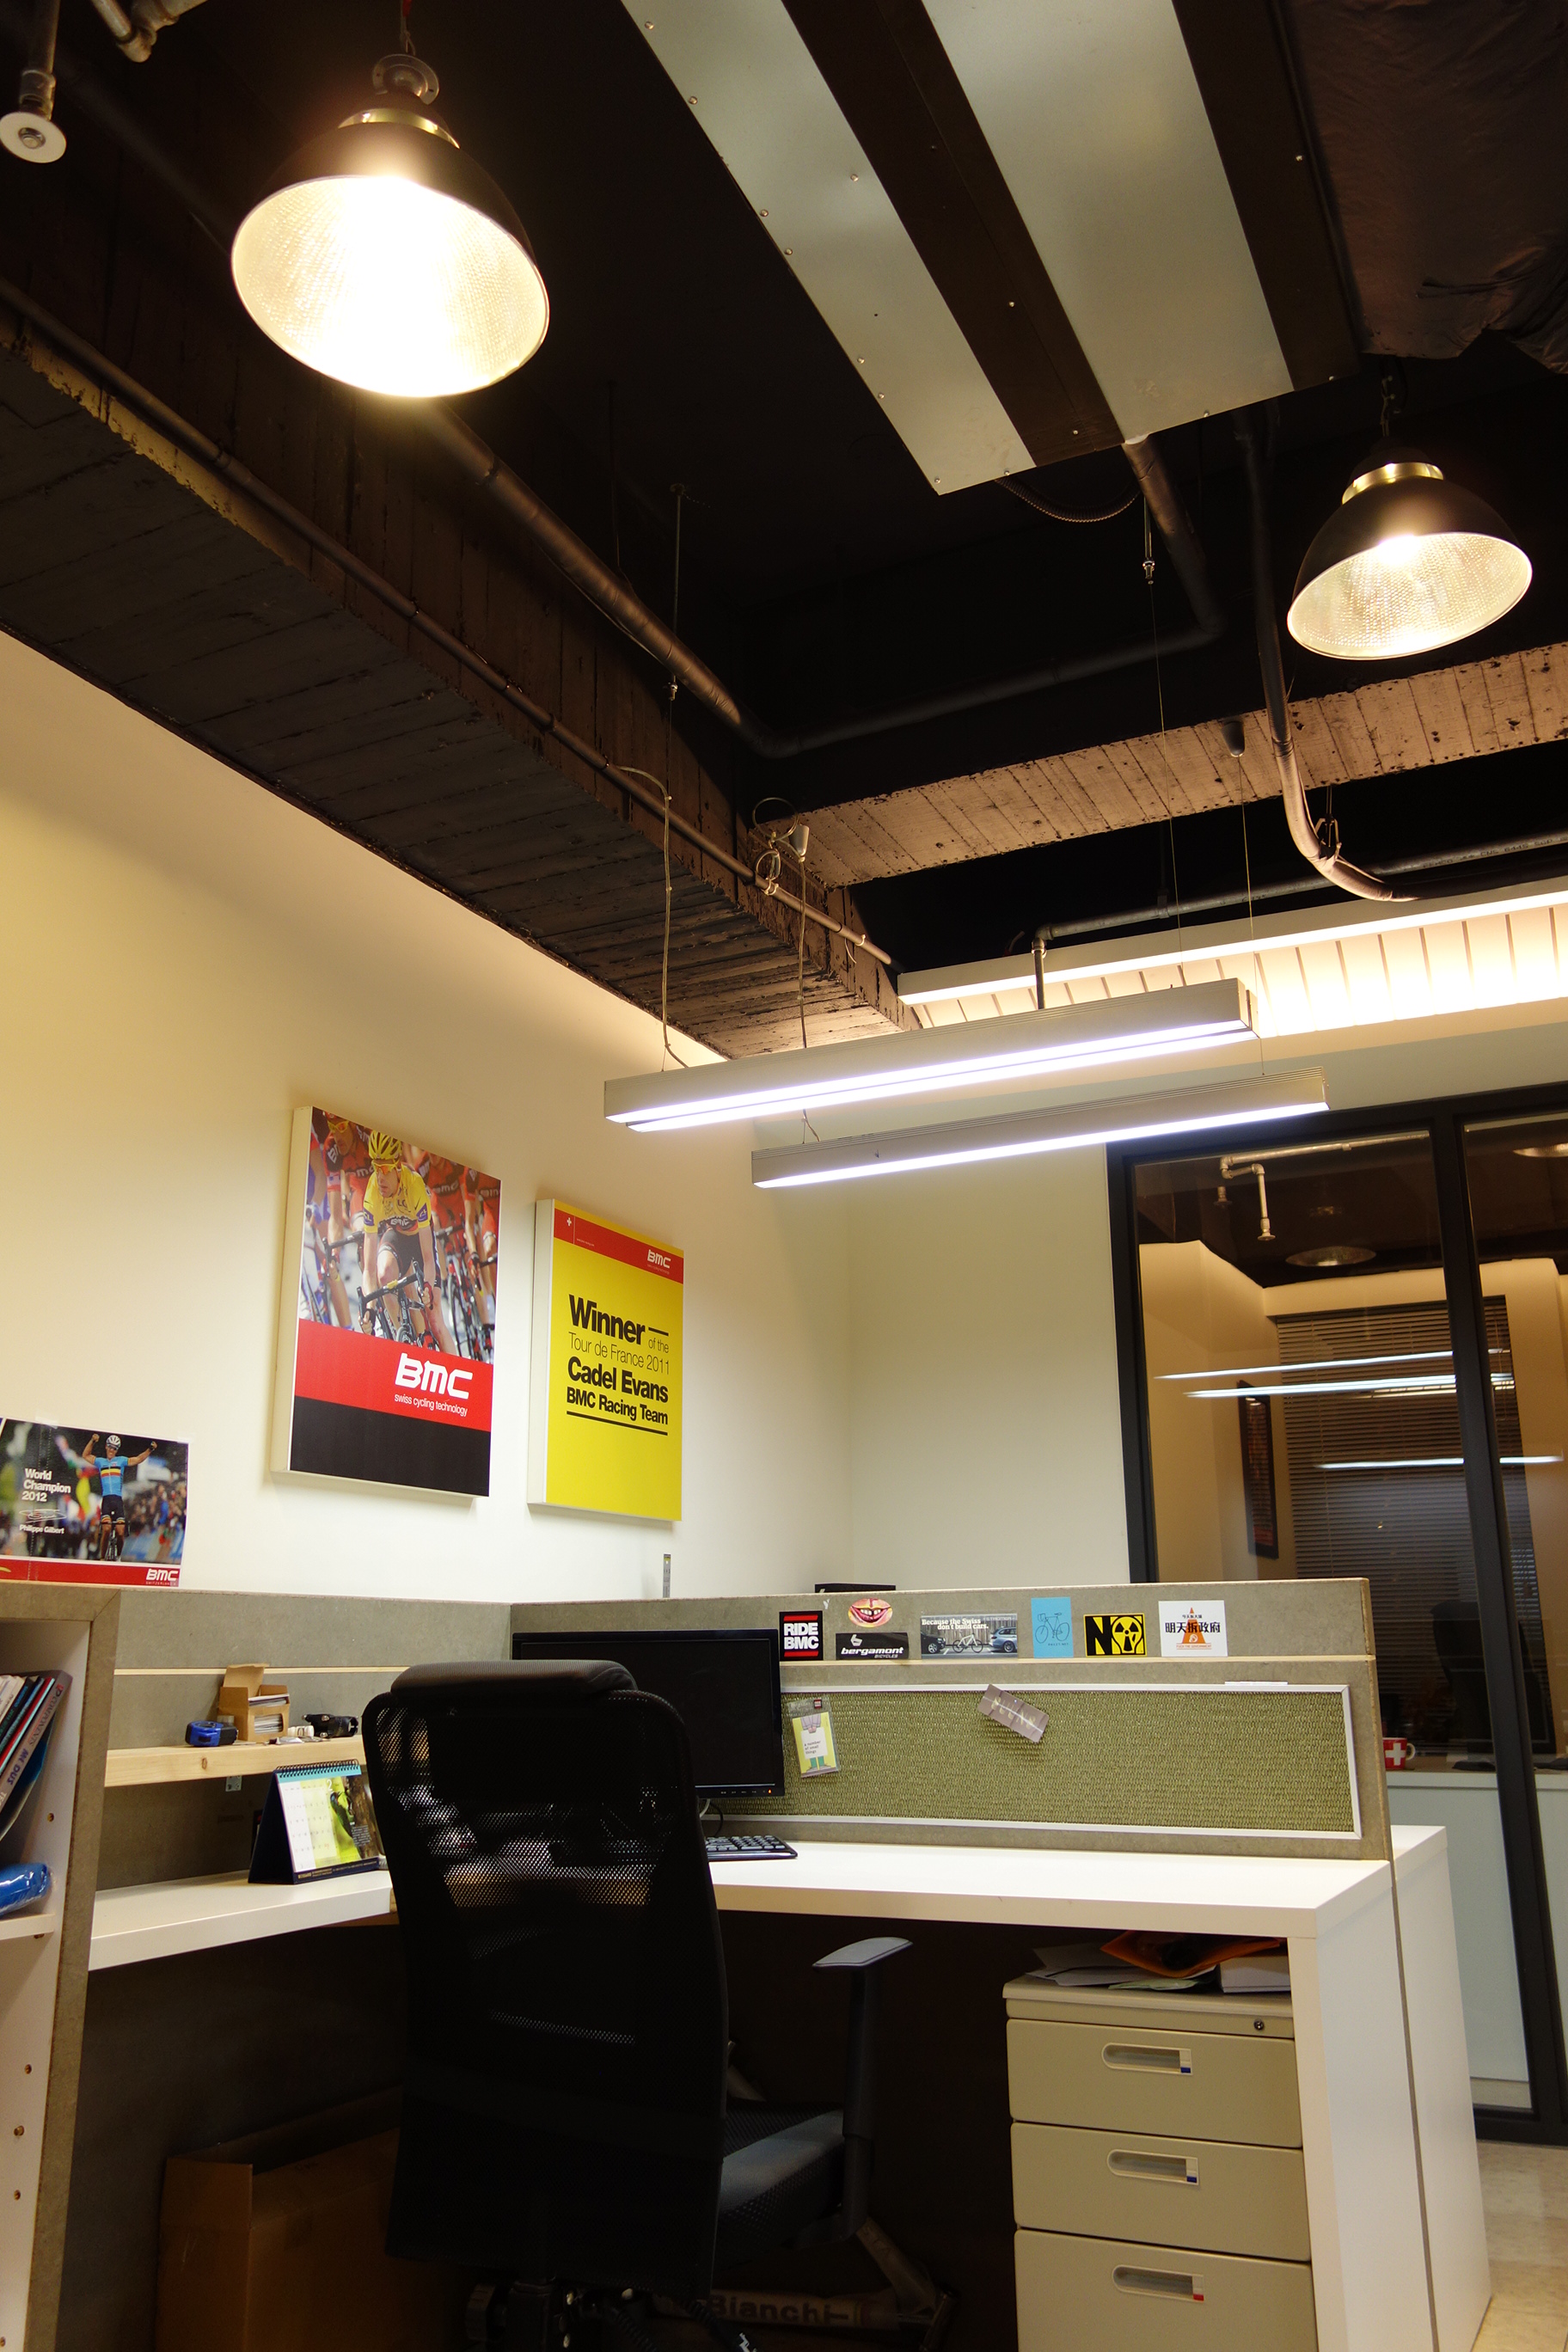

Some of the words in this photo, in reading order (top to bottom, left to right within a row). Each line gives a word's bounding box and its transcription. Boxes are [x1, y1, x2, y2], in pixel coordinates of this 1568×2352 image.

[647, 1249, 671, 1269] BMC
[569, 1294, 646, 1345] Winner
[648, 1338, 656, 1350] of
[657, 1339, 669, 1354] the
[568, 1332, 591, 1353] Tour
[595, 1340, 608, 1357] de
[610, 1344, 644, 1368] France
[646, 1355, 669, 1375] 2011
[395, 1352, 473, 1400] BMC
[568, 1357, 617, 1391] Cadel
[622, 1369, 669, 1403] Evans
[394, 1393, 412, 1405] swiss
[413, 1397, 435, 1412] cycling
[435, 1400, 468, 1417] technology
[567, 1386, 596, 1409] BMC
[598, 1394, 637, 1422] Racing
[639, 1403, 669, 1425] Team
[25, 1467, 52, 1480] World
[23, 1480, 71, 1494] Champion
[21, 1491, 47, 1503] 2012
[146, 1568, 179, 1582] BMC
[783, 1622, 818, 1636] RIDE
[1165, 1621, 1221, 1633] 明天拆政府
[783, 1636, 819, 1650] BMC
[841, 1646, 904, 1656] bergamont
[327, 1779, 334, 1792] 2
